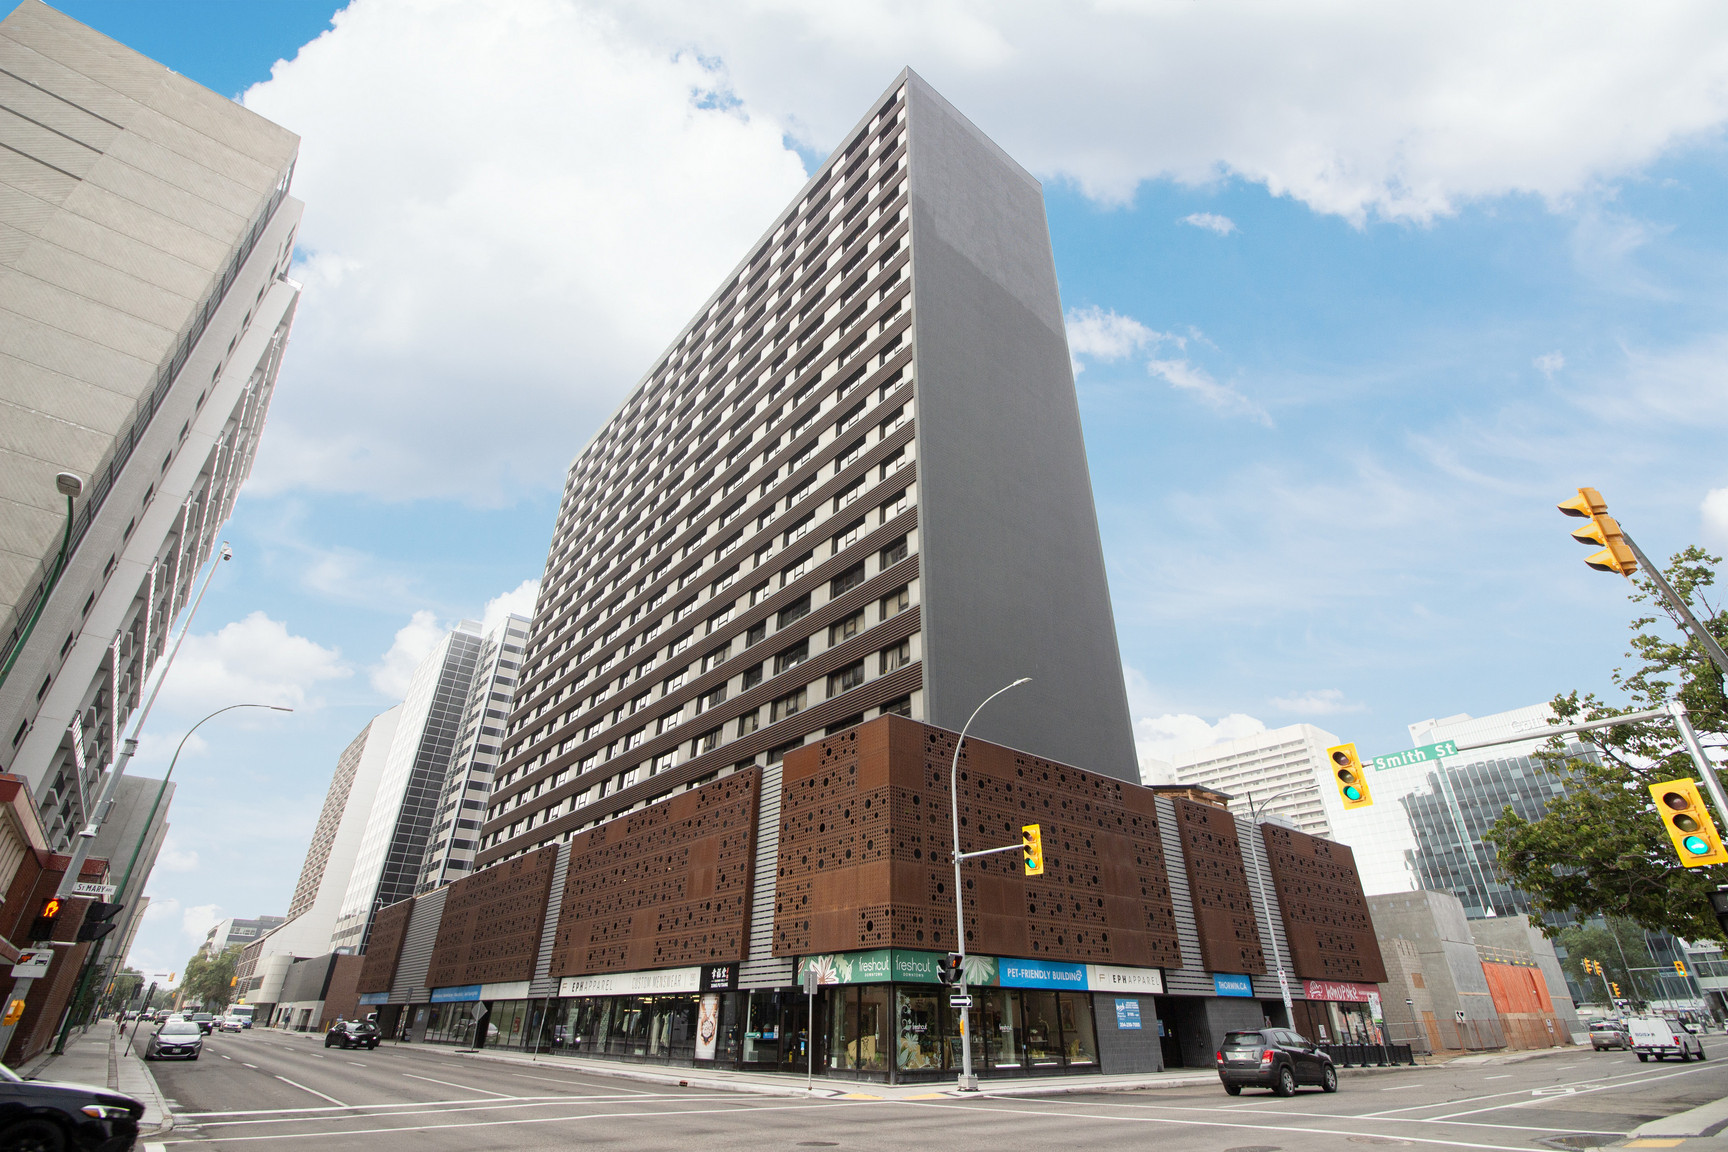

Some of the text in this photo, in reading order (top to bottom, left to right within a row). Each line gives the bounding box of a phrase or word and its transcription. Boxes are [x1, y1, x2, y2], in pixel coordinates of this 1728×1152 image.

[1376, 743, 1455, 770] Smith St
[85, 884, 106, 893] MARY
[859, 955, 889, 972] freshcut
[896, 955, 930, 973] freshcut
[631, 976, 652, 990] CUSTOM
[653, 974, 681, 988] MENSWEAR
[1007, 968, 1083, 982] PET-FRIENDLY BUILDING
